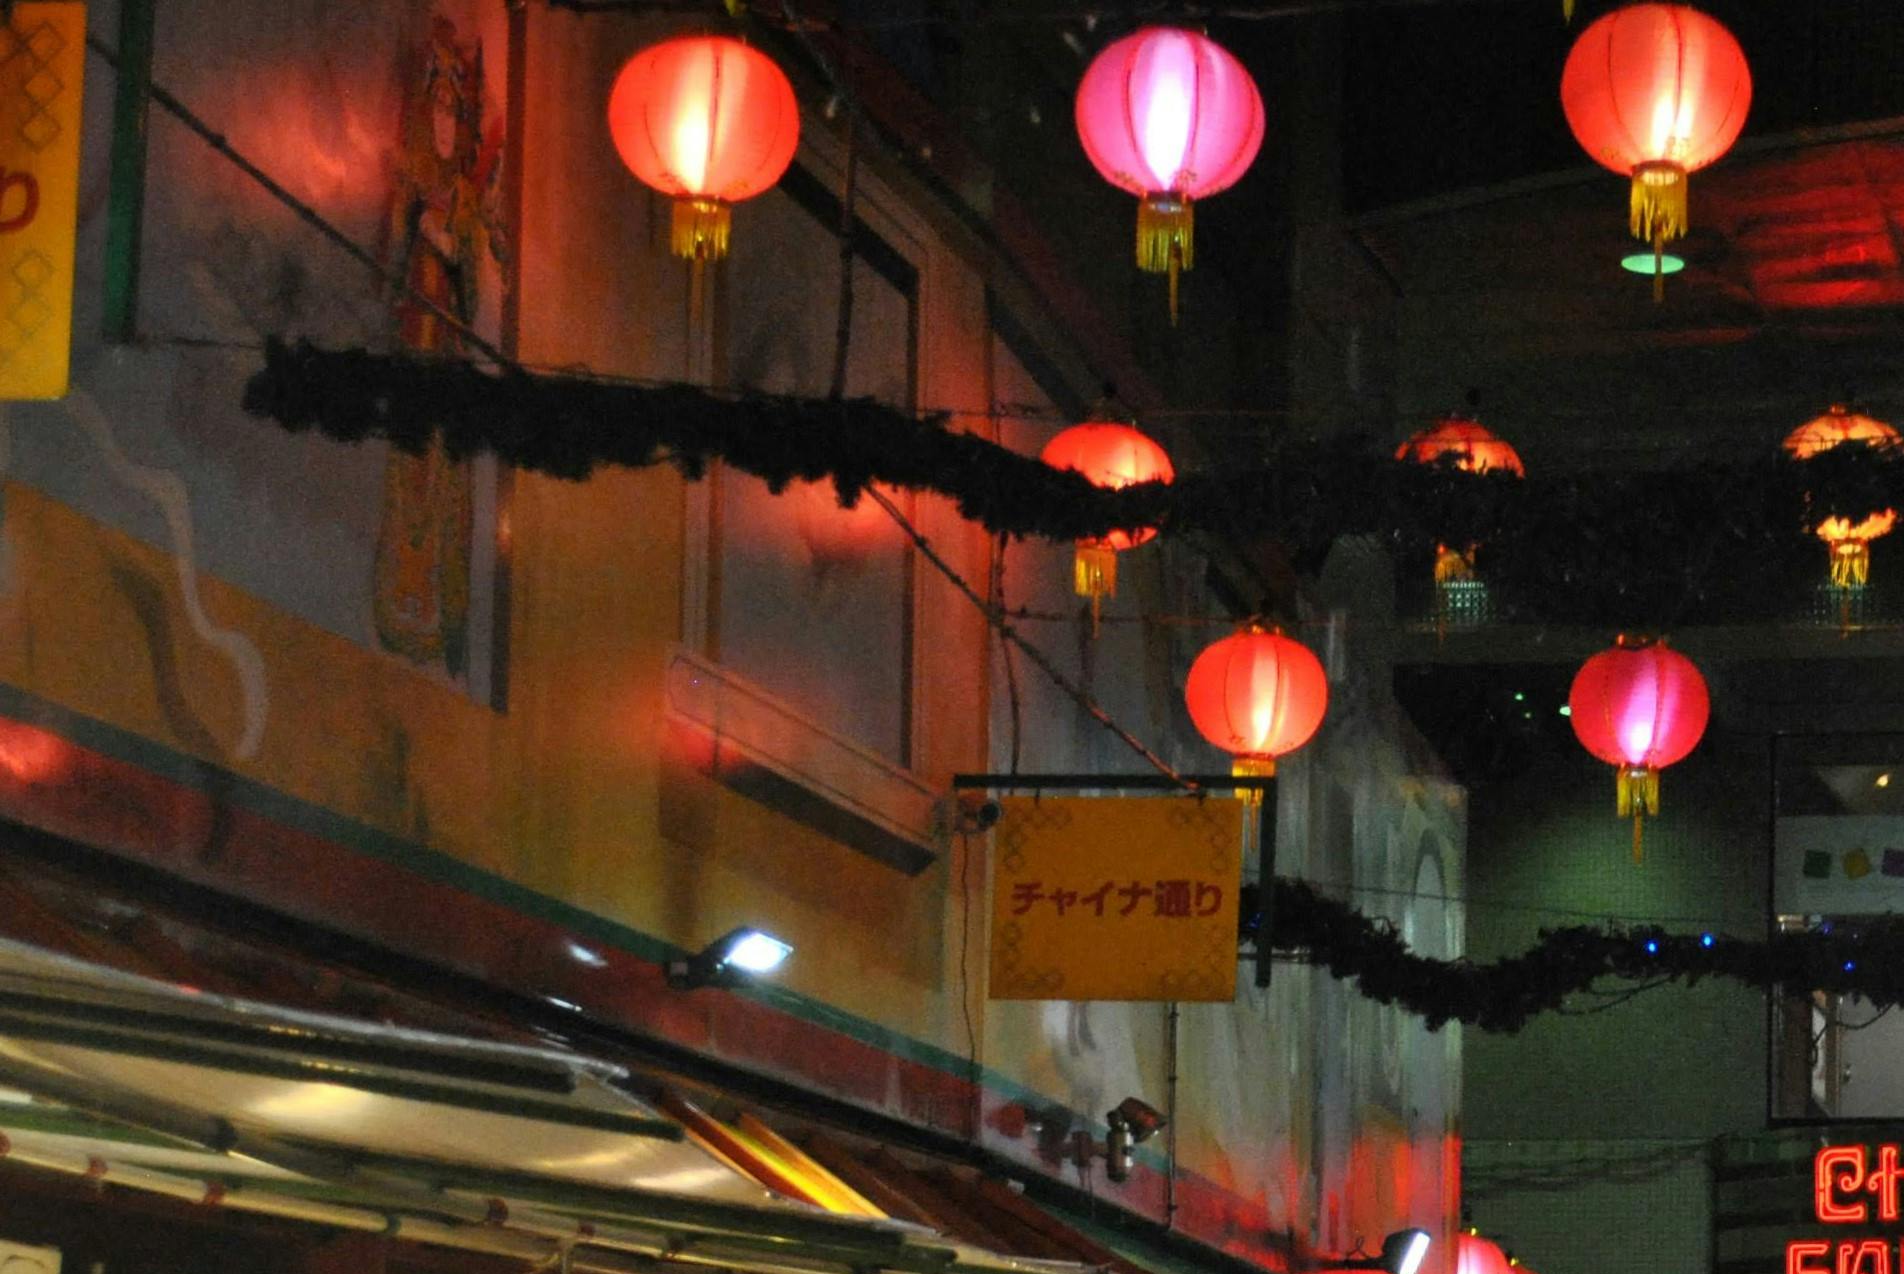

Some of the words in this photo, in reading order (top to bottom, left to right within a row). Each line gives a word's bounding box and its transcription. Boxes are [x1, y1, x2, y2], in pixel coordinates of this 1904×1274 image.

[1009, 878, 1224, 919] チャイナ通り
